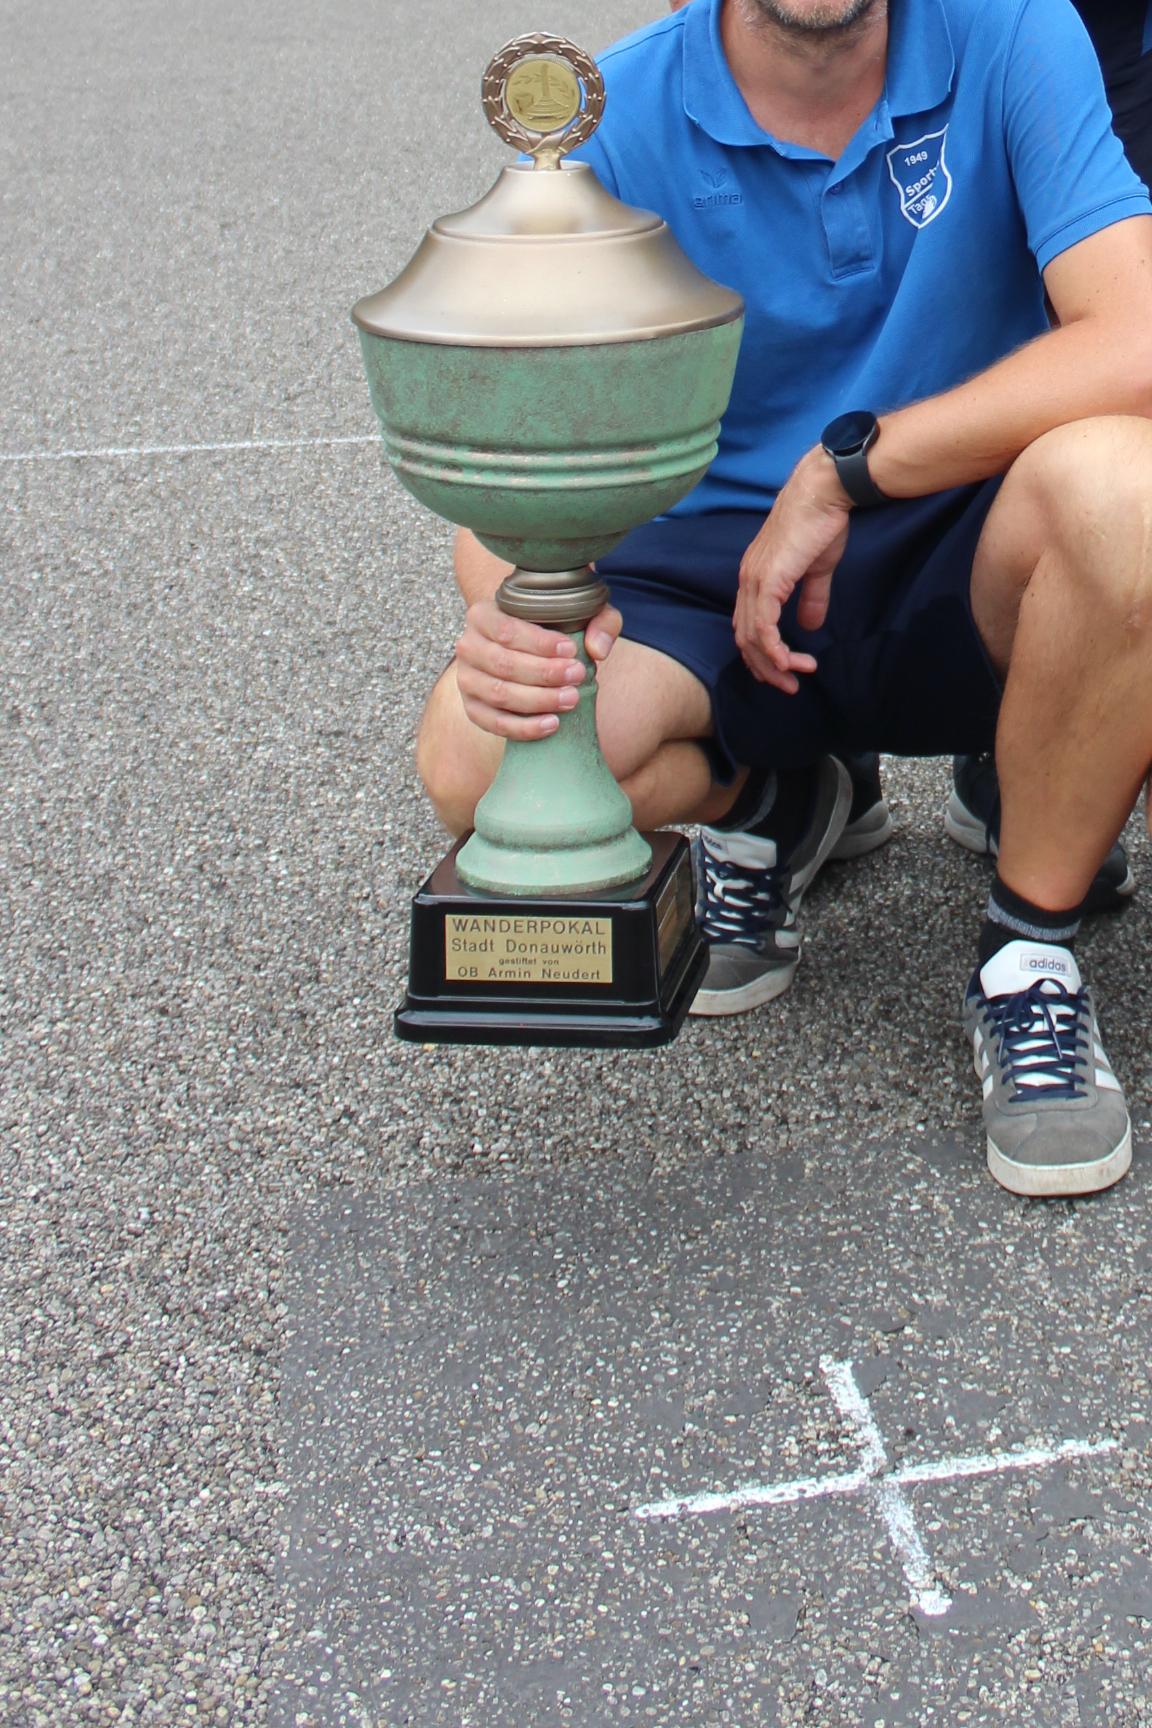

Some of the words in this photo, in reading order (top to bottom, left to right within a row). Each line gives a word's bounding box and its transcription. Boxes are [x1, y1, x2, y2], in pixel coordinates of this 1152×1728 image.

[904, 151, 928, 167] 1949
[452, 918, 606, 935] WANDERPOKAL
[451, 938, 496, 953] Stadt
[505, 939, 607, 955] Donauwörth
[1029, 956, 1068, 973] adidas
[457, 967, 479, 978] OB
[488, 967, 532, 979] Armin
[541, 968, 601, 981] Neudert
